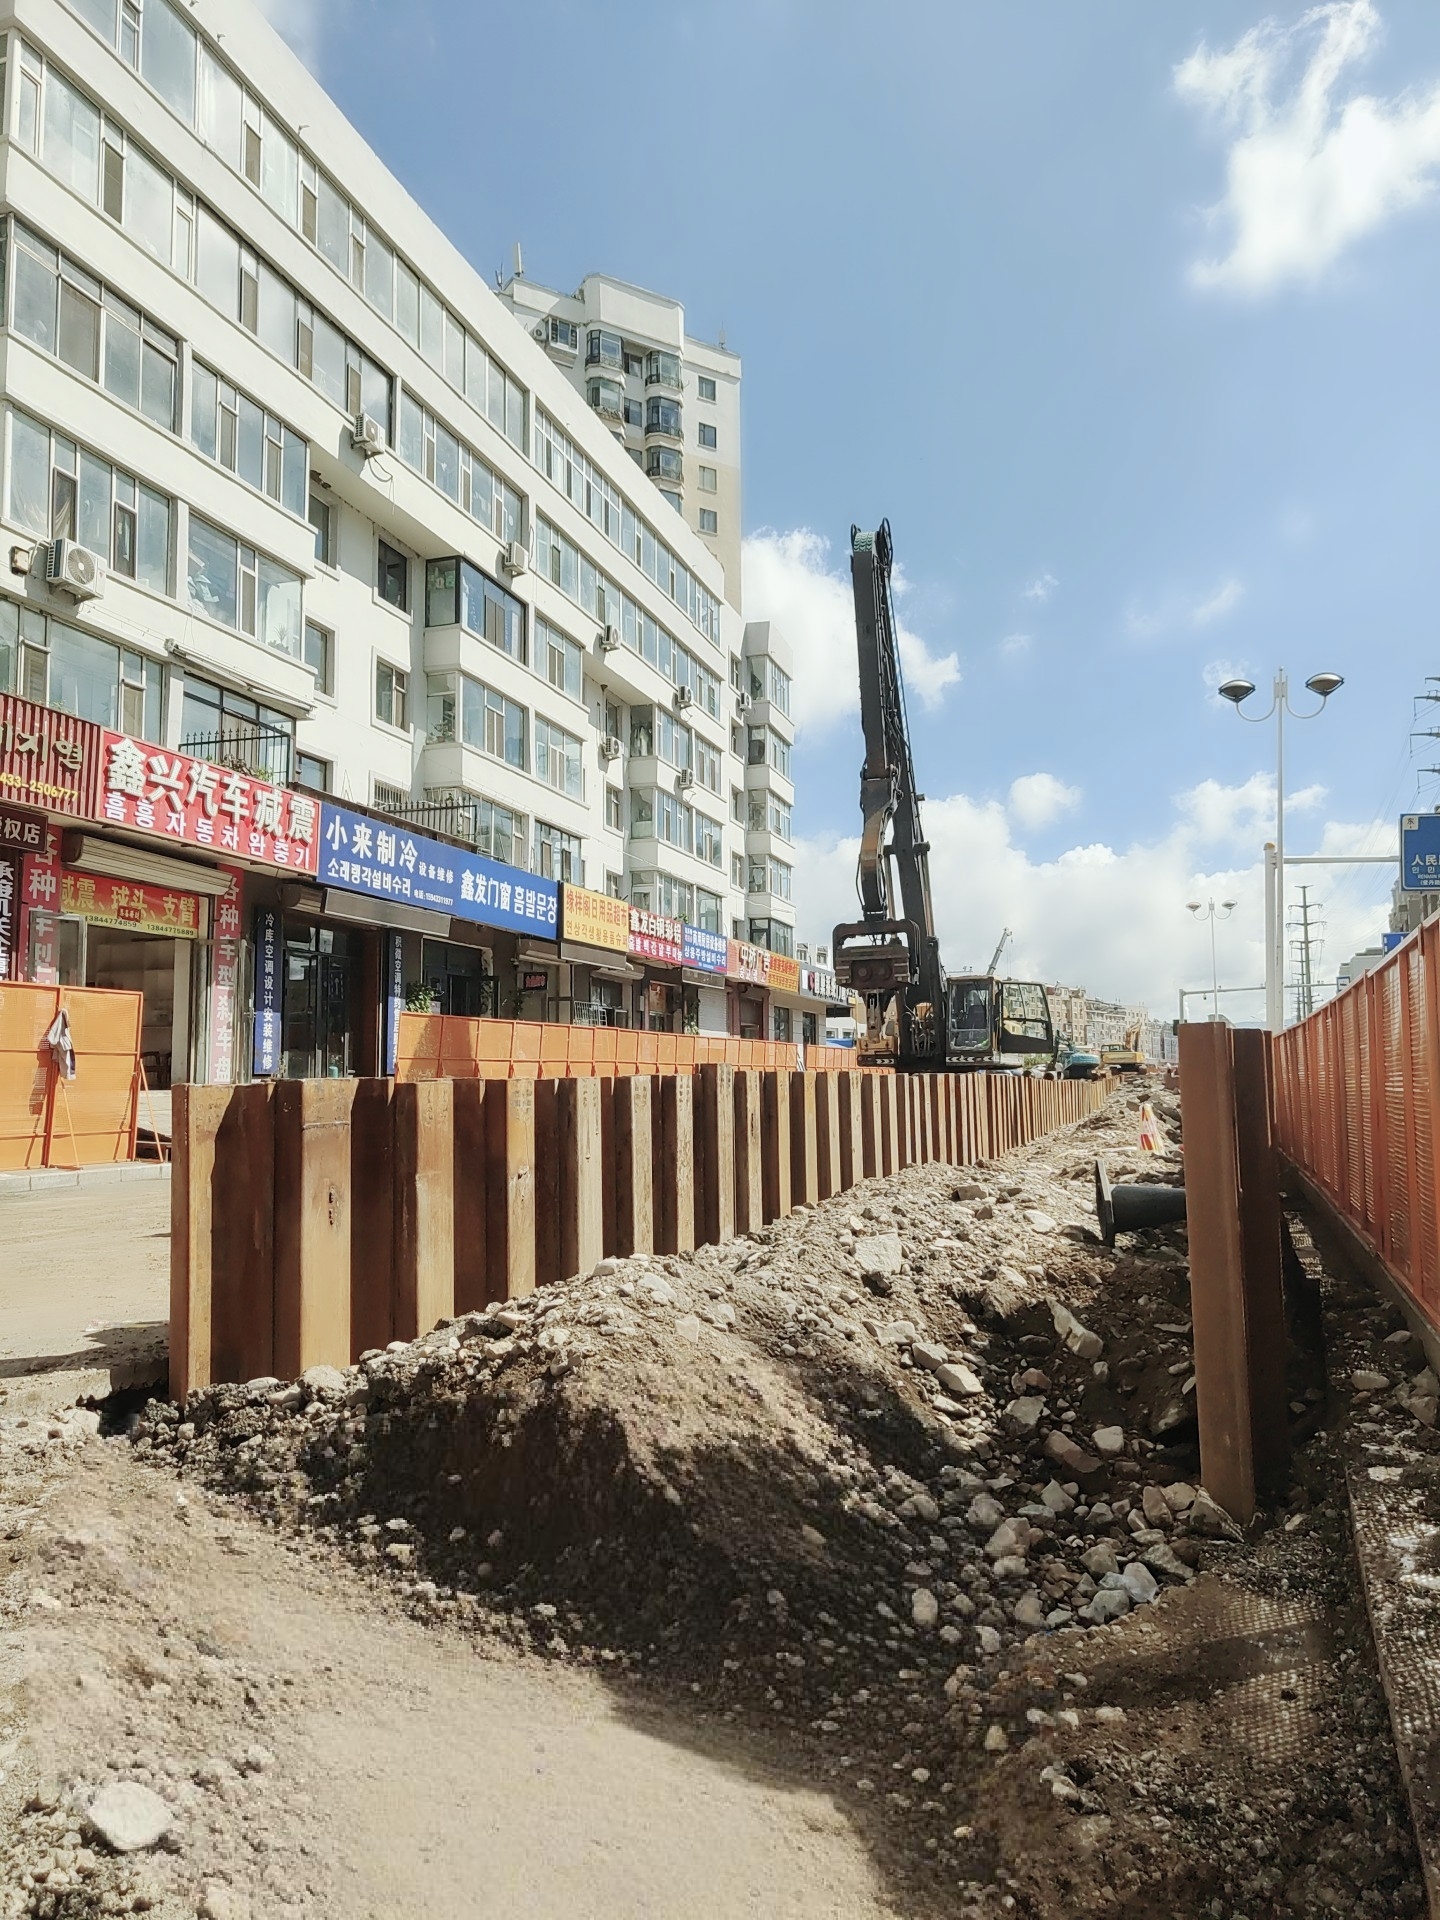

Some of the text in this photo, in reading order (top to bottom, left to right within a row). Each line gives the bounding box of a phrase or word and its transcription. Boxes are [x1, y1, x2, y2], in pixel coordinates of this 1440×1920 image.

[108, 737, 316, 845] 鑫兴汽车减震
[0, 817, 41, 845] 权店
[326, 815, 454, 884] 小来制冷 设备维修
[1411, 854, 1440, 866] 人民
[461, 869, 511, 912] 鑫发门窗
[262, 912, 275, 1070] 冷库空调设计安装维修
